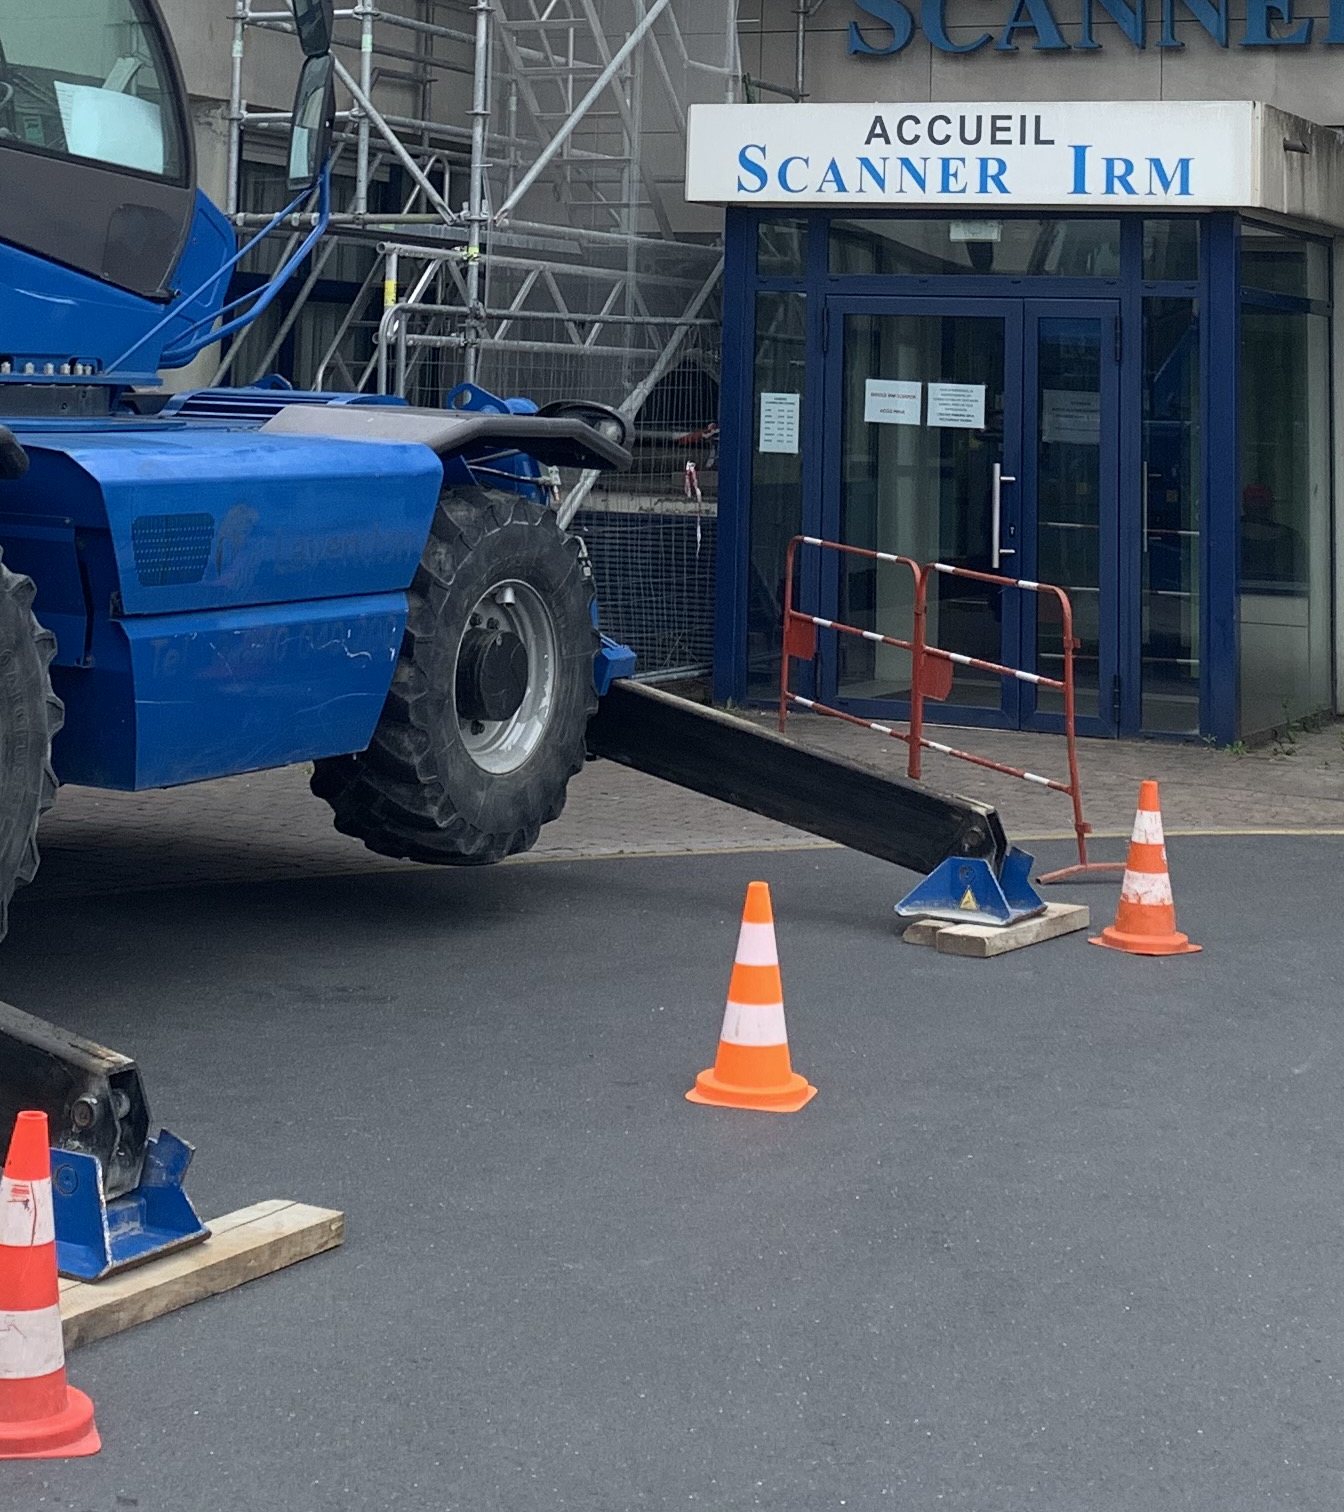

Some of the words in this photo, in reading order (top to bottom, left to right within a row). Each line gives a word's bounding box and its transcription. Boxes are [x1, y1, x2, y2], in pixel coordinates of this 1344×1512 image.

[865, 115, 1055, 146] ACCUEIL
[737, 143, 1012, 194] SCANNER
[1067, 144, 1195, 197] IRM
